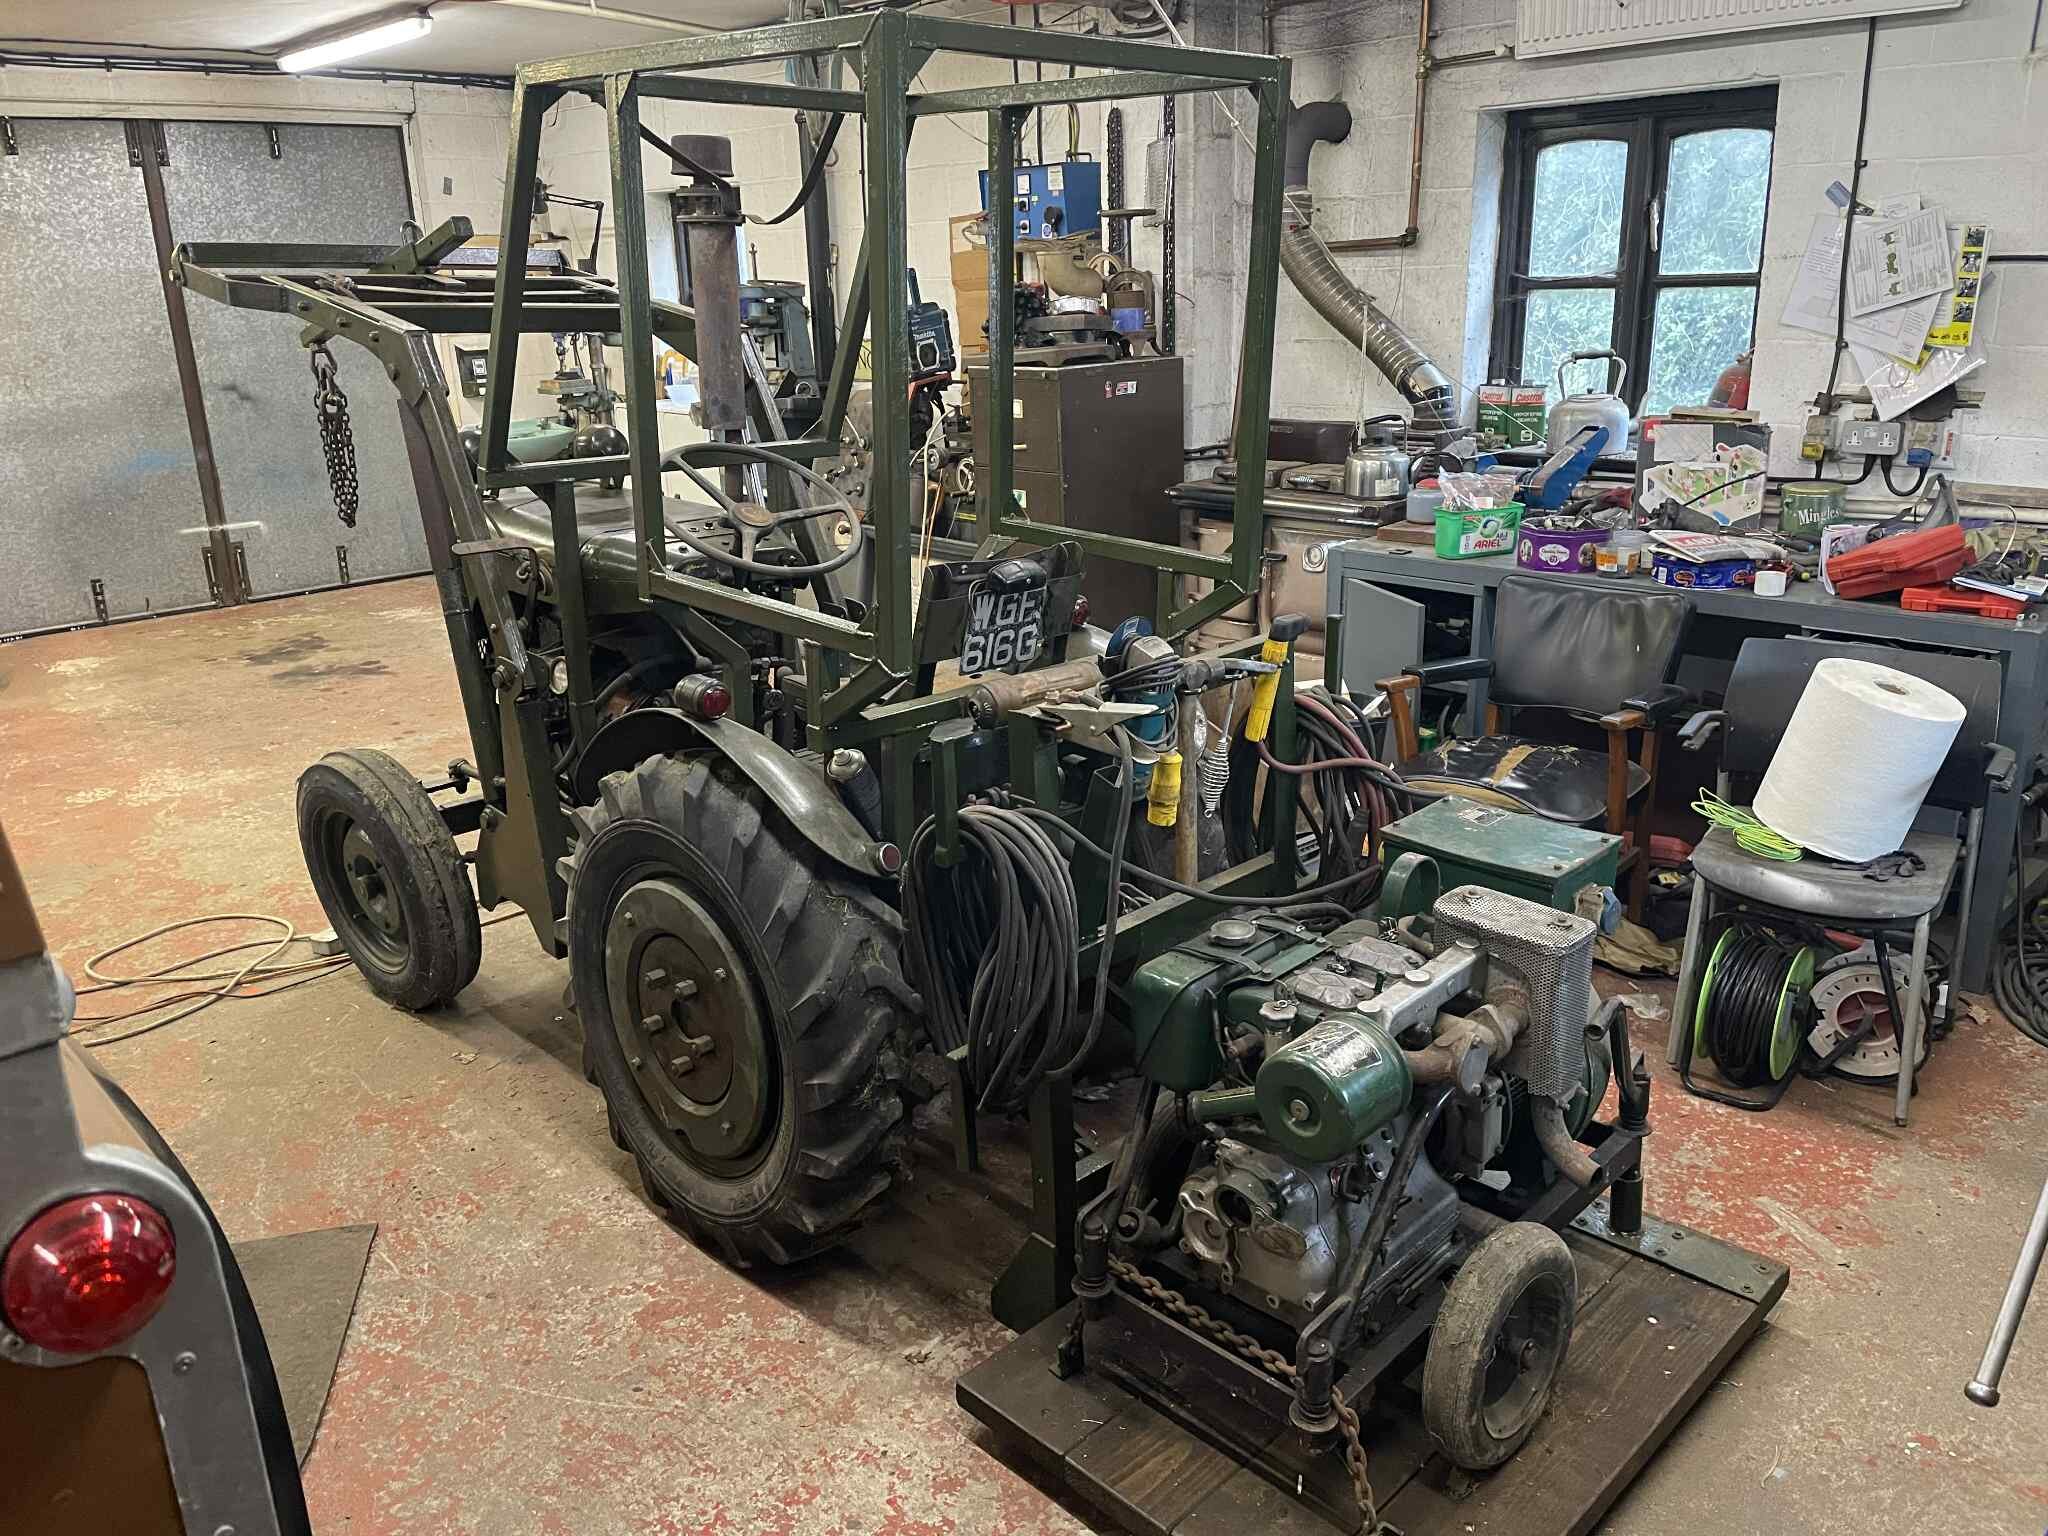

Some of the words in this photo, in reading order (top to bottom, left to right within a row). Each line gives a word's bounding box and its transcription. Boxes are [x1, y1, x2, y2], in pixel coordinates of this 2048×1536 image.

[1798, 506, 1840, 526] Mingles
[1473, 539, 1501, 549] ARIEL
[962, 623, 1039, 673] 616G
